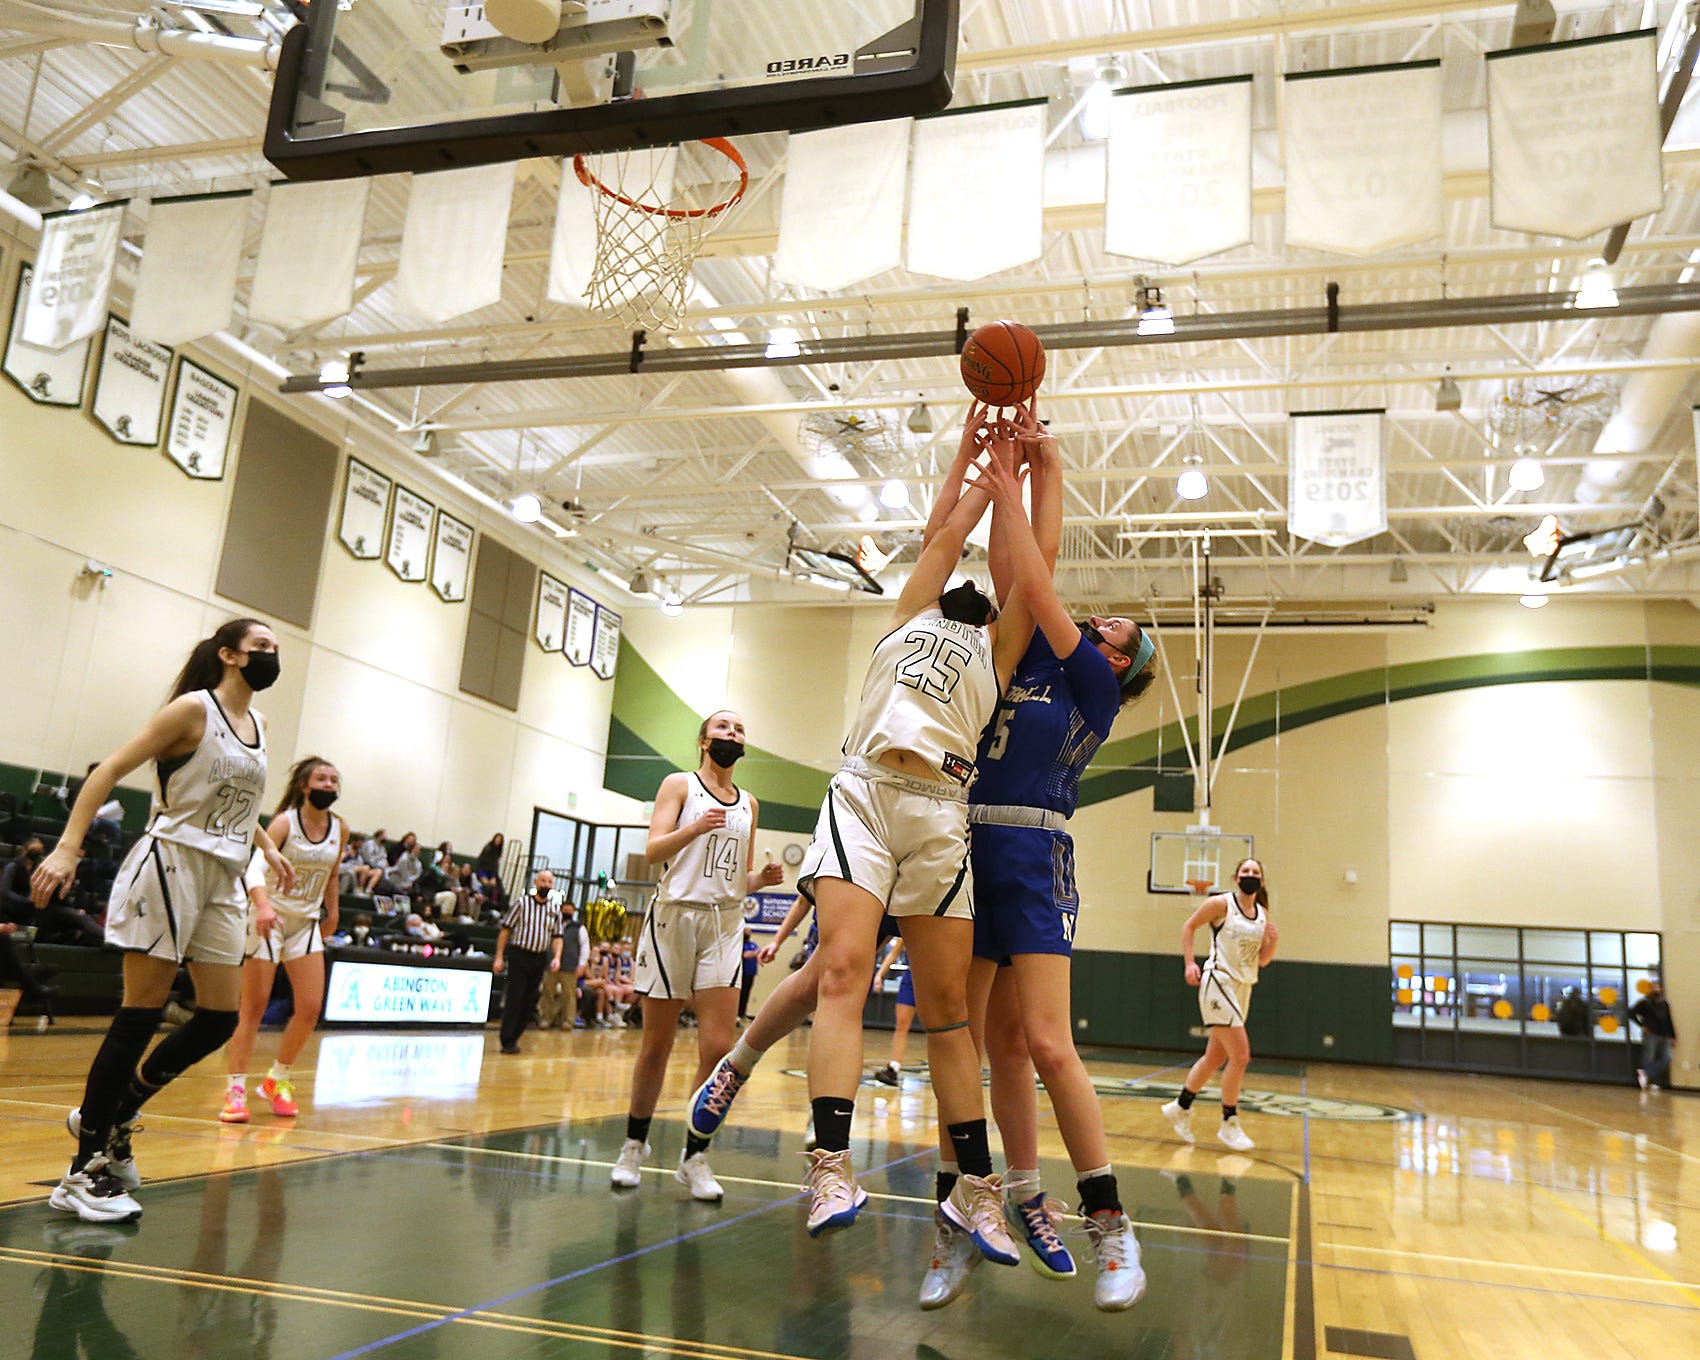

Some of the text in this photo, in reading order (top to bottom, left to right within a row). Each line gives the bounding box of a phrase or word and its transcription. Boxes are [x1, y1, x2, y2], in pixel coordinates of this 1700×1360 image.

[894, 630, 973, 704] 25
[204, 784, 256, 844] 22
[704, 834, 739, 881] 14
[373, 995, 453, 1013] GREEN WAVE
[383, 975, 448, 993] ABINGTON
